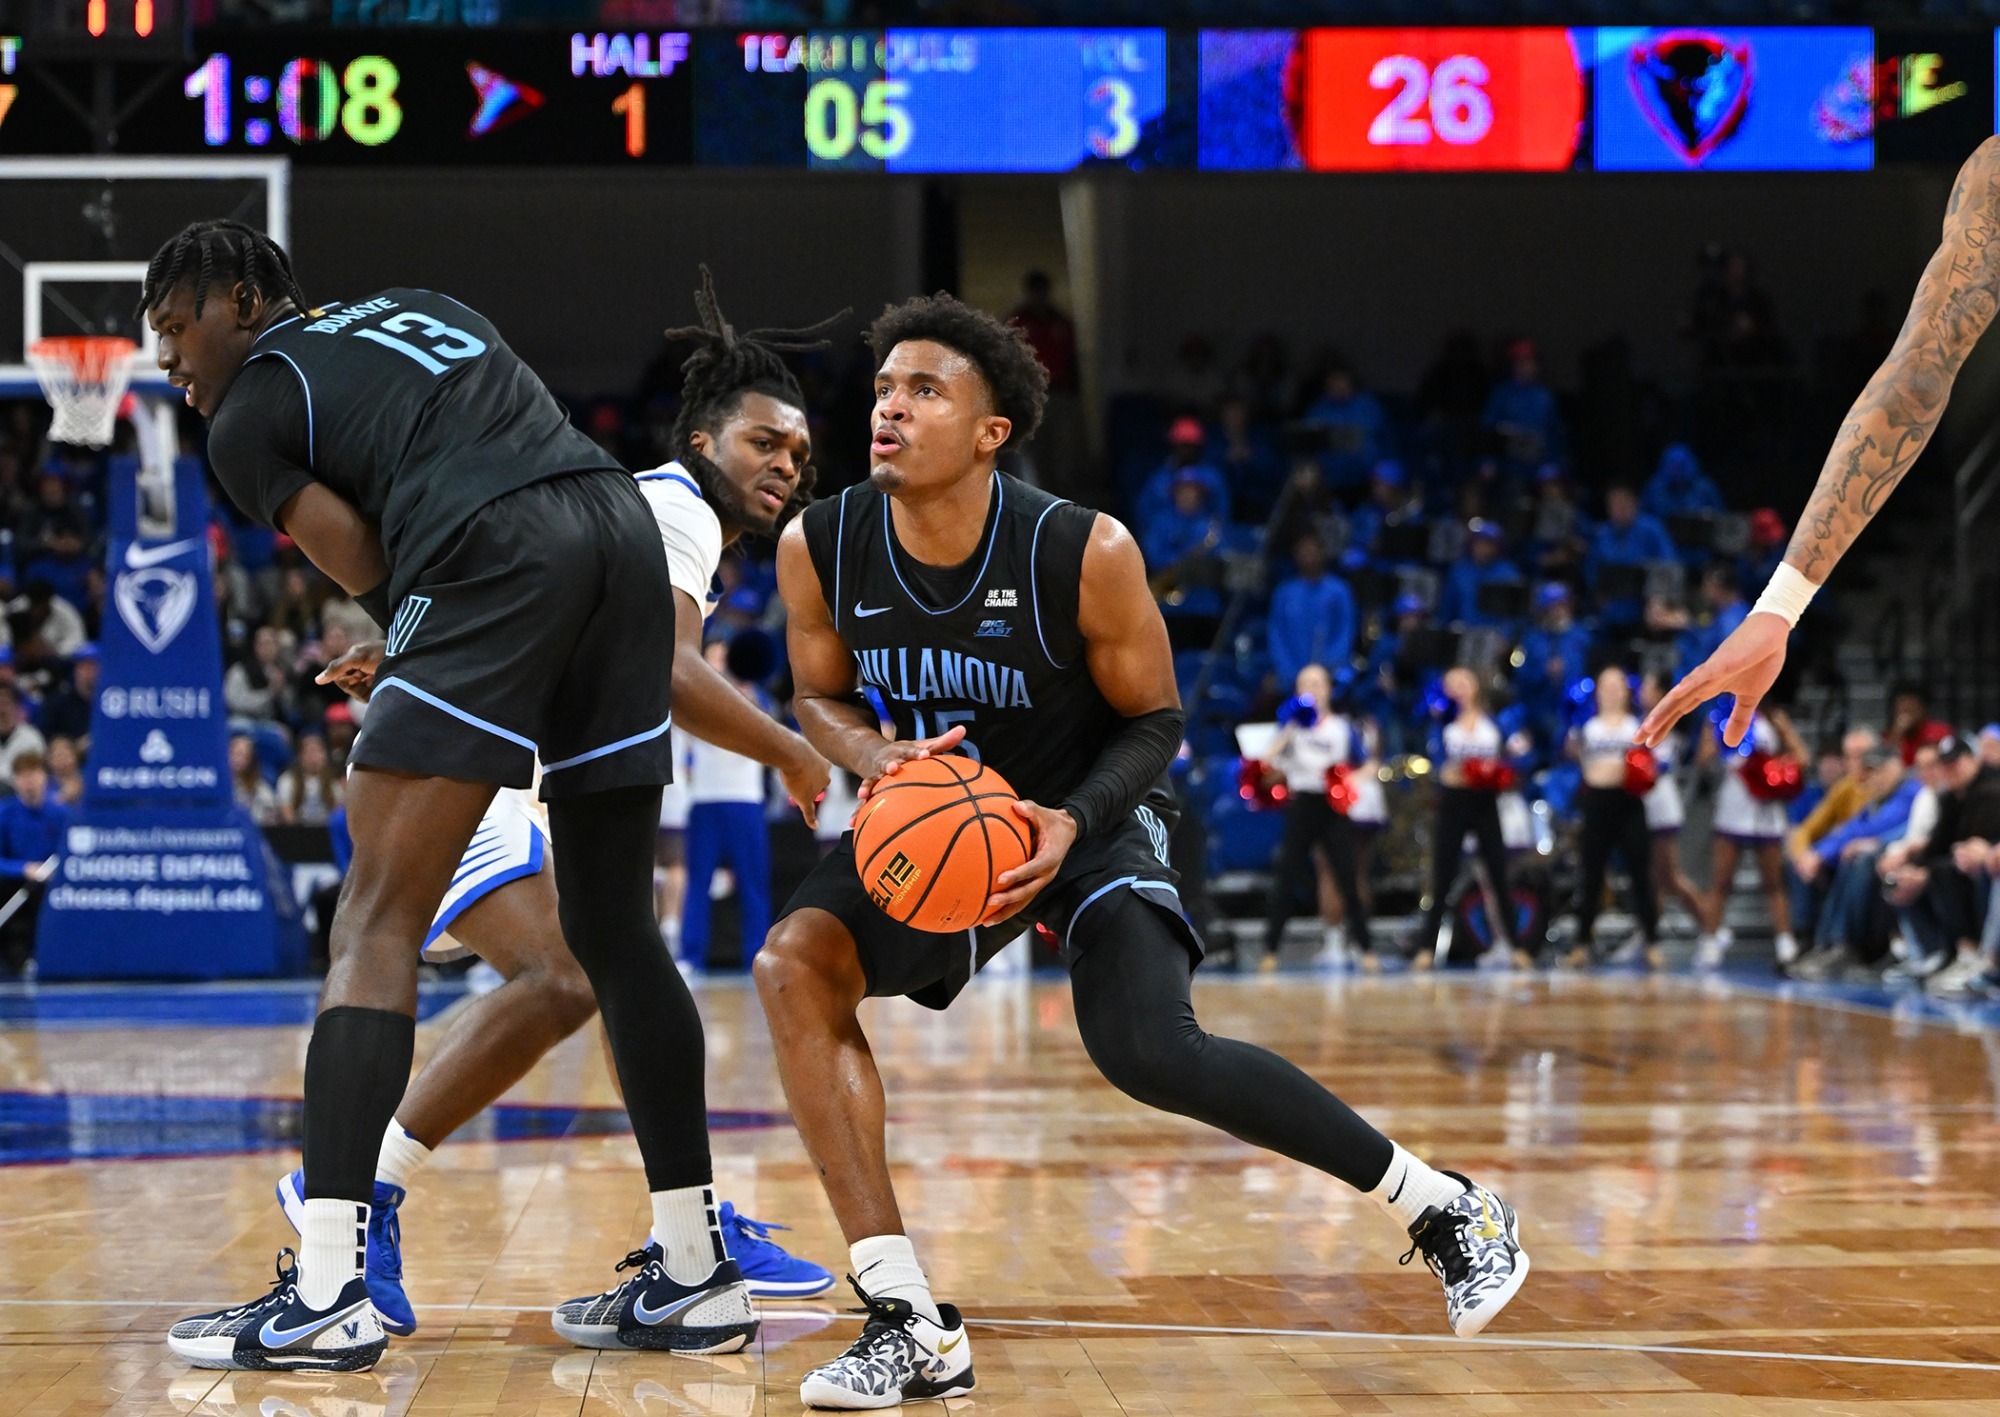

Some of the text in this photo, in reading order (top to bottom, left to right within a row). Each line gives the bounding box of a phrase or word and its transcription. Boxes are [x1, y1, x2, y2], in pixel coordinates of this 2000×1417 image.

[570, 32, 690, 78] HALF
[184, 53, 403, 147] 1:08
[611, 83, 647, 158] 1
[805, 78, 912, 160] 05
[1084, 77, 1142, 159] 3
[1368, 54, 1495, 147] 26
[353, 311, 487, 375] 13
[984, 598, 1018, 607] CHANGE
[988, 589, 1017, 598] BE THE
[853, 647, 1034, 709] VILLANOVA
[894, 868, 922, 906] IONSHIP
